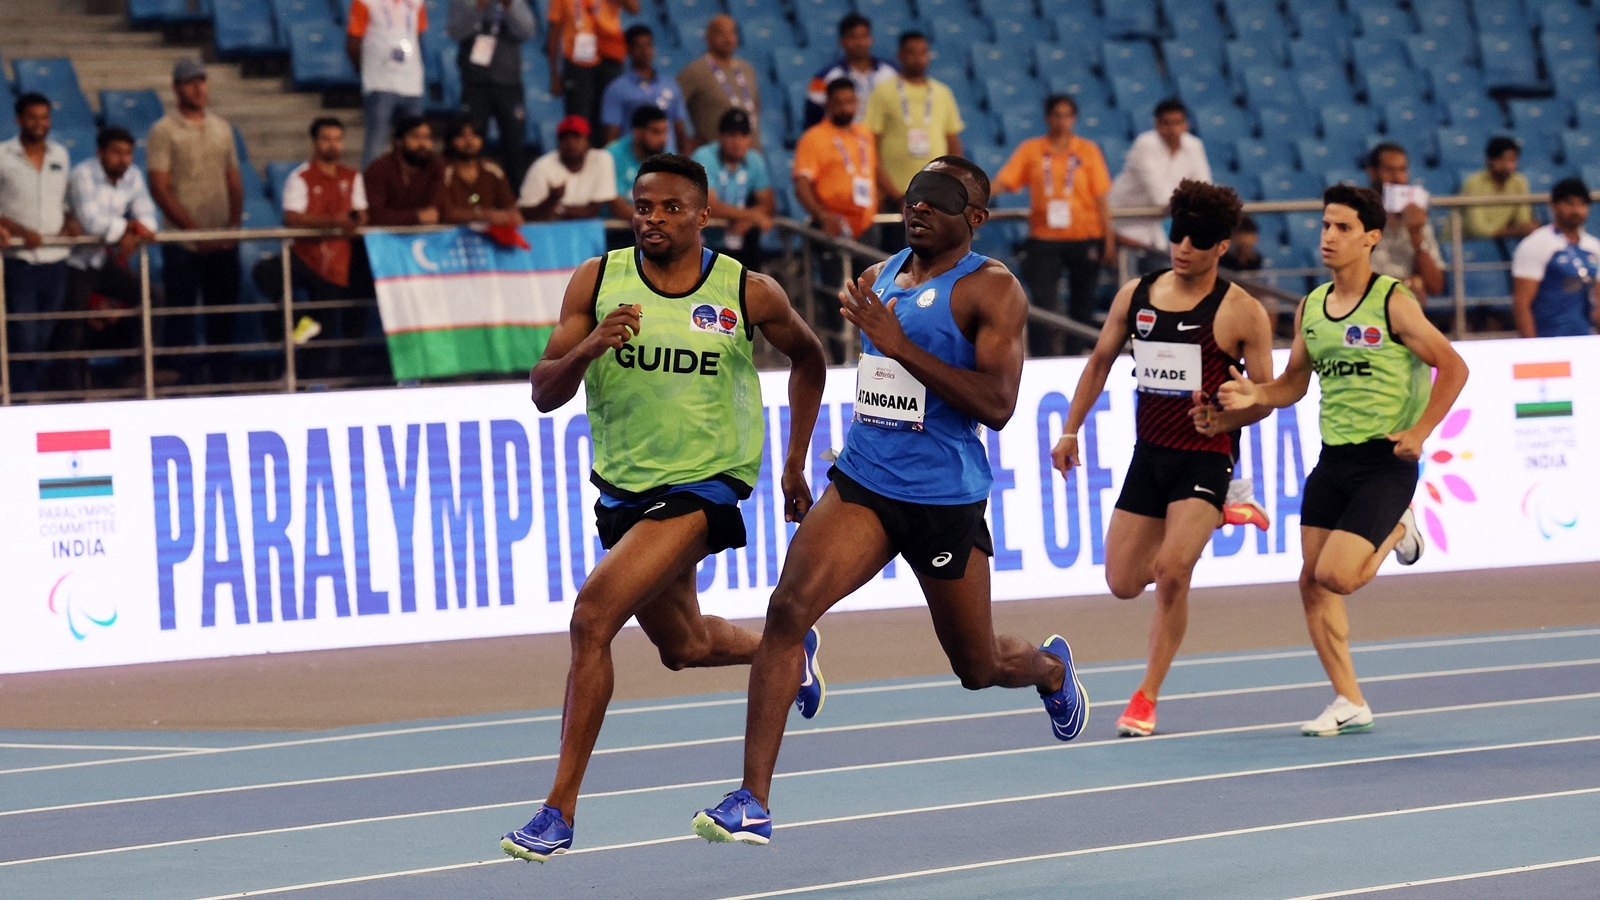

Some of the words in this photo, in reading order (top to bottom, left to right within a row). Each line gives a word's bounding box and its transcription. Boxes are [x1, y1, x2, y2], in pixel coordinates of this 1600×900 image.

[615, 343, 720, 376] GUIDE
[1144, 367, 1186, 380] AYADE
[858, 389, 919, 411] ATANGANA
[150, 413, 608, 631] PARALYMPIC
[1037, 390, 1113, 569] OF
[52, 538, 106, 558] INDIA
